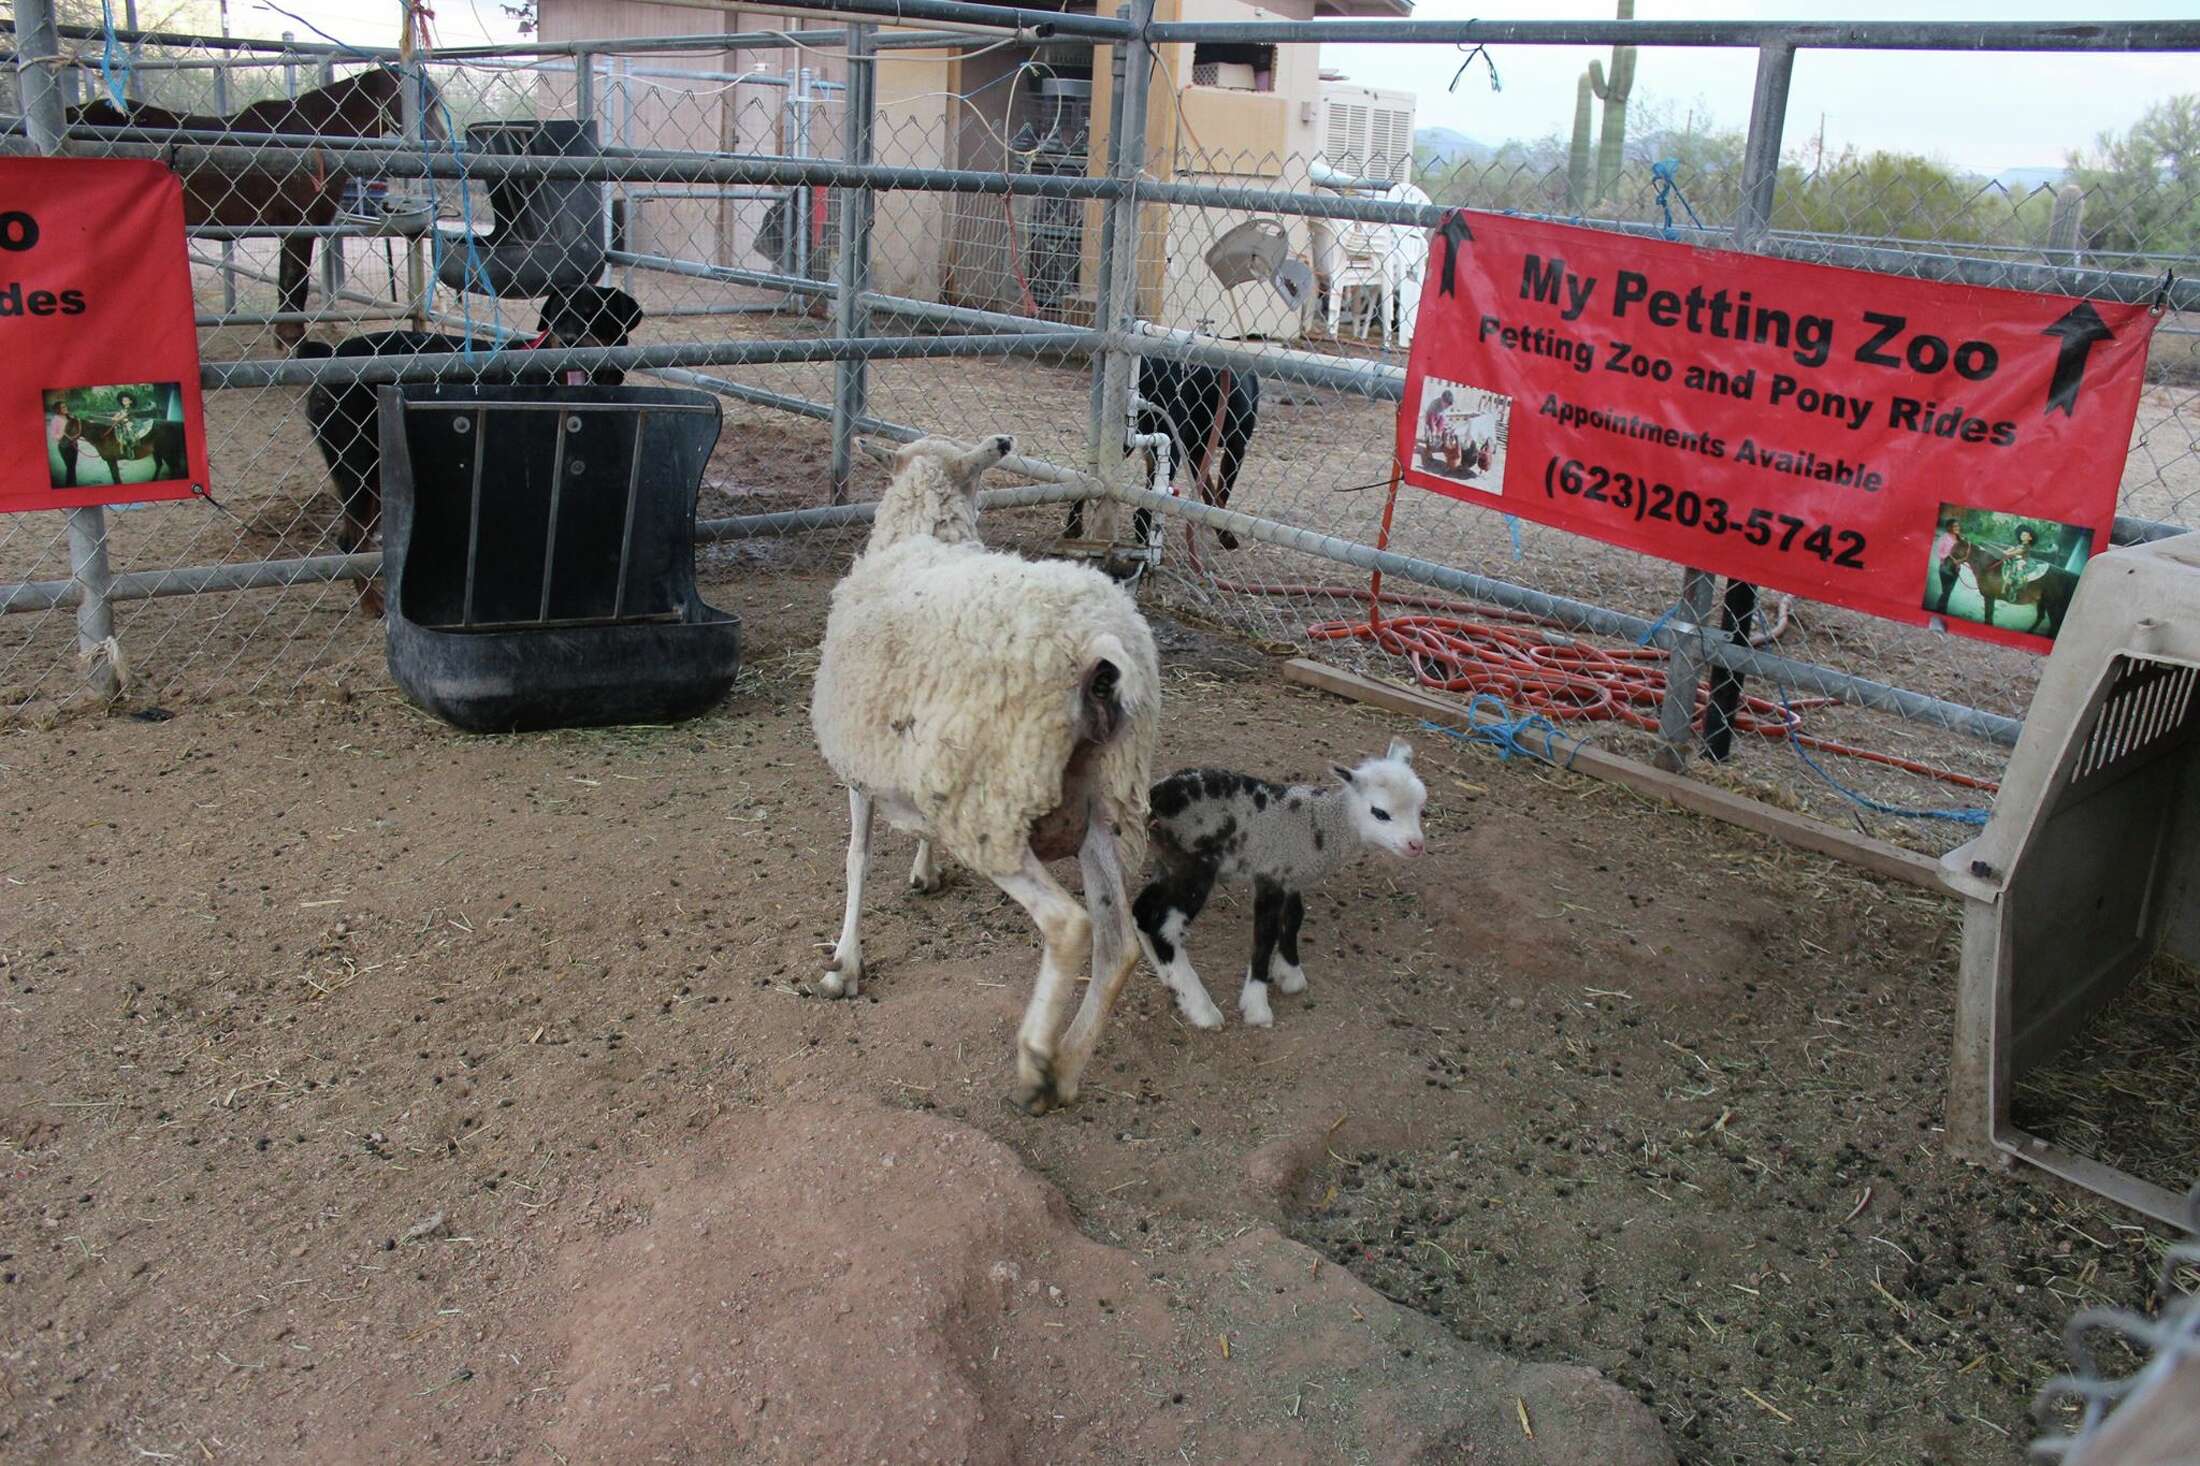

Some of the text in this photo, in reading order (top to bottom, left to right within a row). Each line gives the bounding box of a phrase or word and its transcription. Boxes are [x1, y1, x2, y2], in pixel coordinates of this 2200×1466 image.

[1519, 254, 2000, 381] My Petting Zoo
[1479, 316, 2017, 446] Petting Zoo and Pony Rides
[1540, 393, 1883, 493] Appointments Available
[1545, 456, 1867, 570] (623)203-5742
